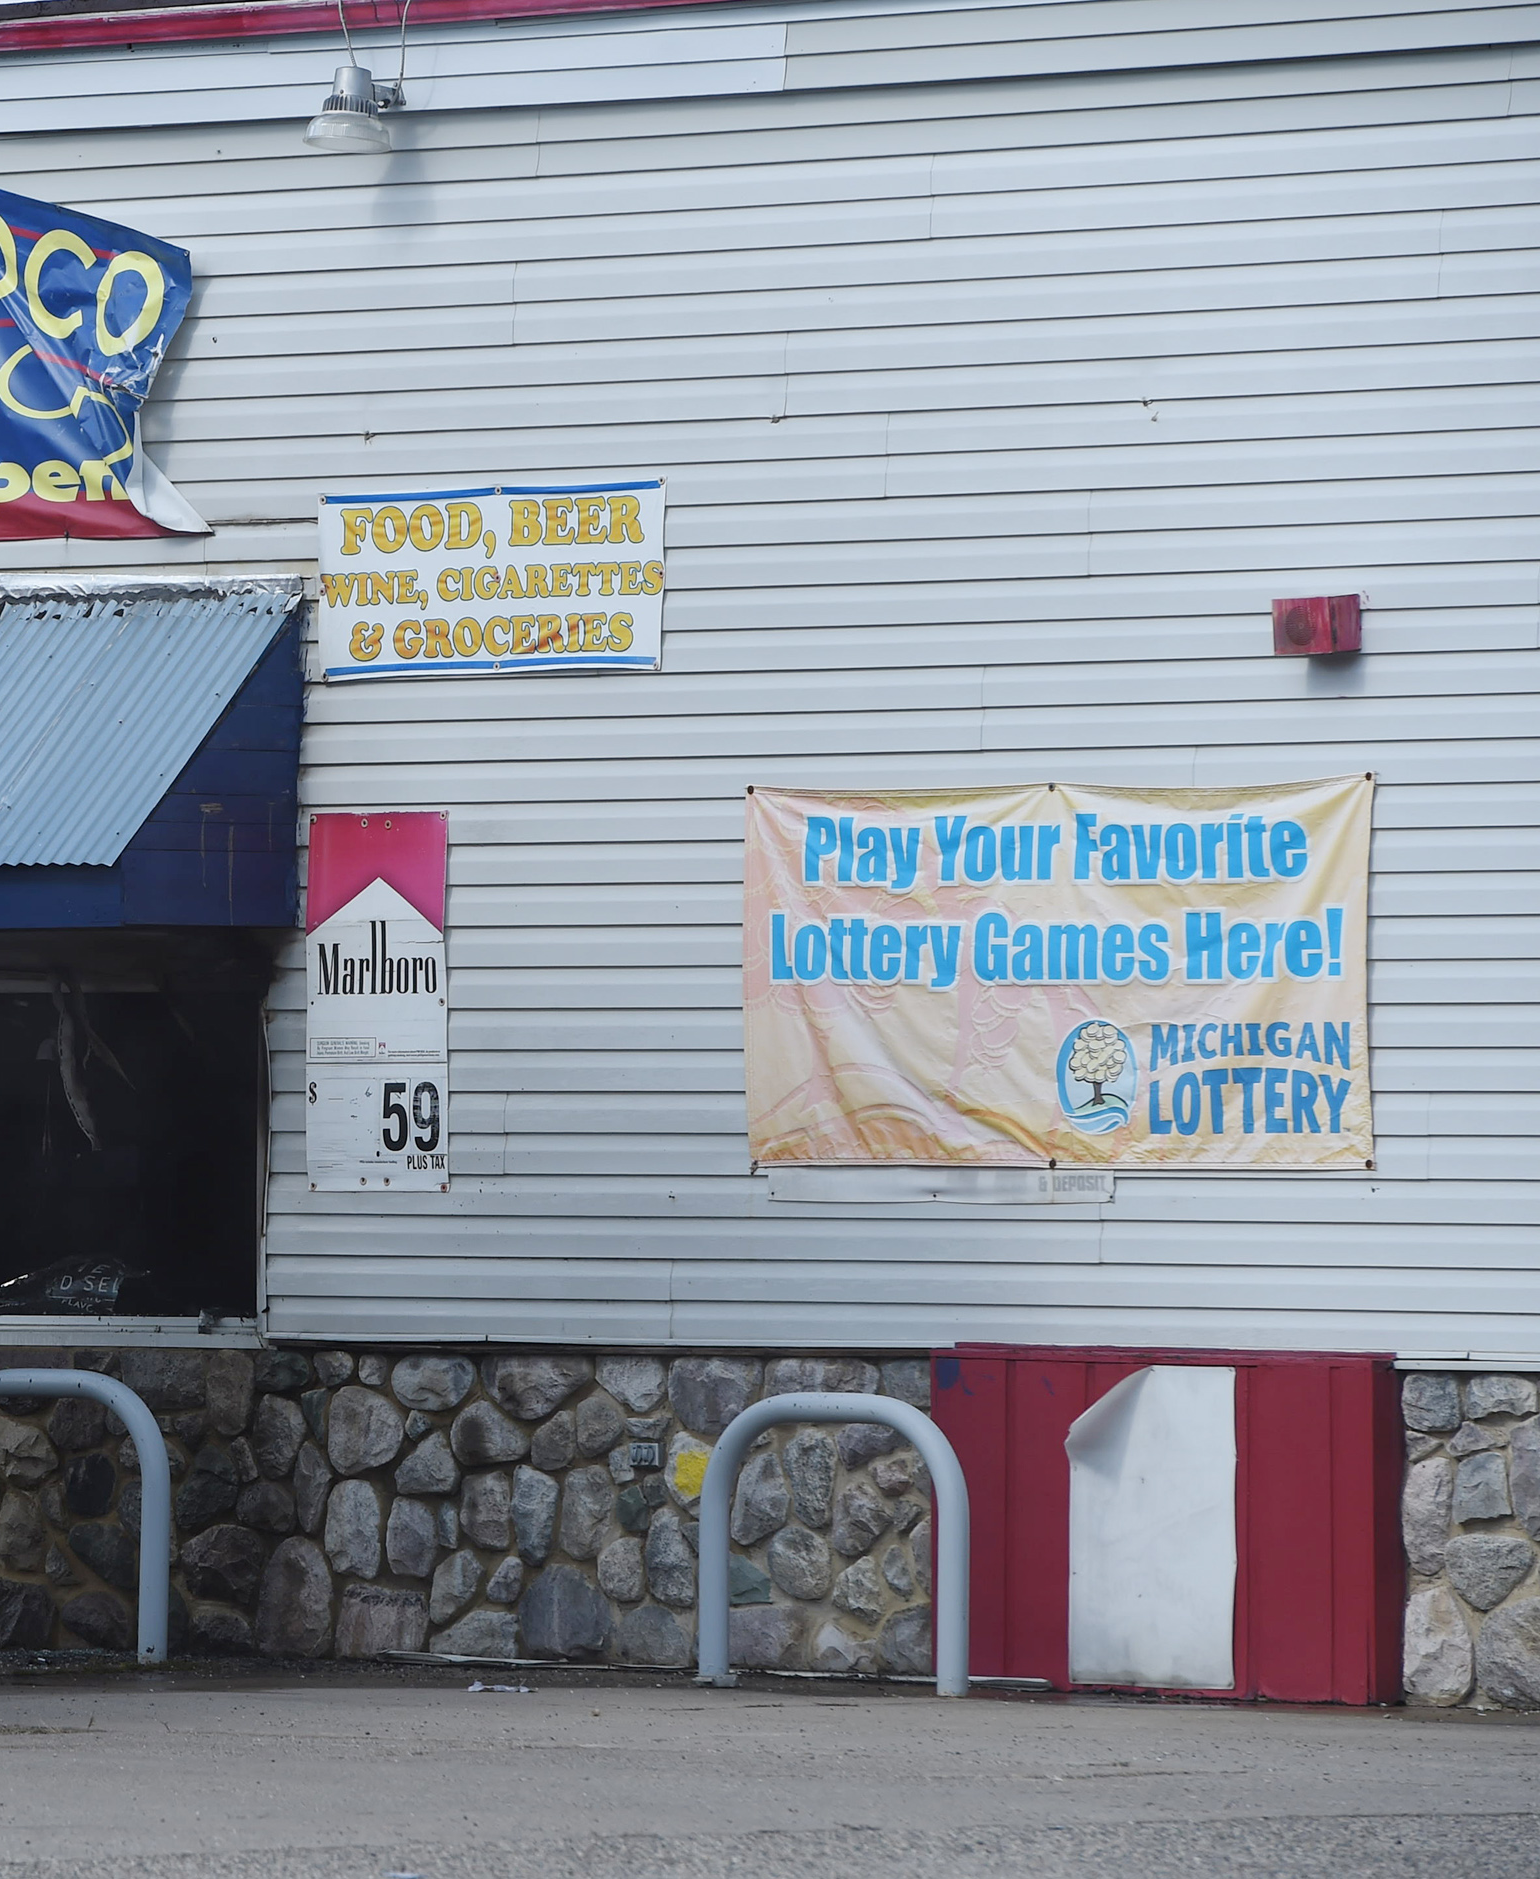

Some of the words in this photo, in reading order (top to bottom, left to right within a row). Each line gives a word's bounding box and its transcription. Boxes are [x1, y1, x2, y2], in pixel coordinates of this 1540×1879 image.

[340, 501, 497, 559] FOOD,
[508, 495, 645, 547] BEER
[321, 569, 429, 610] WINE,
[436, 560, 664, 602] CIGARETTES
[349, 621, 385, 662] &
[392, 611, 634, 659] GROCERIES
[803, 814, 920, 890] Play
[936, 814, 1061, 883] Your
[1073, 812, 1309, 881] Favorite
[317, 920, 438, 995] Marlboro
[769, 912, 962, 988] Lottery
[973, 912, 1170, 983] Games
[1184, 907, 1344, 982] Here!
[1149, 1020, 1351, 1072] MICHIGAN
[1148, 1067, 1351, 1136] LOTTERY
[406, 1154, 429, 1170] PLUS
[429, 1154, 446, 1171] TAX
[1053, 1174, 1108, 1192] DEPOSIT
